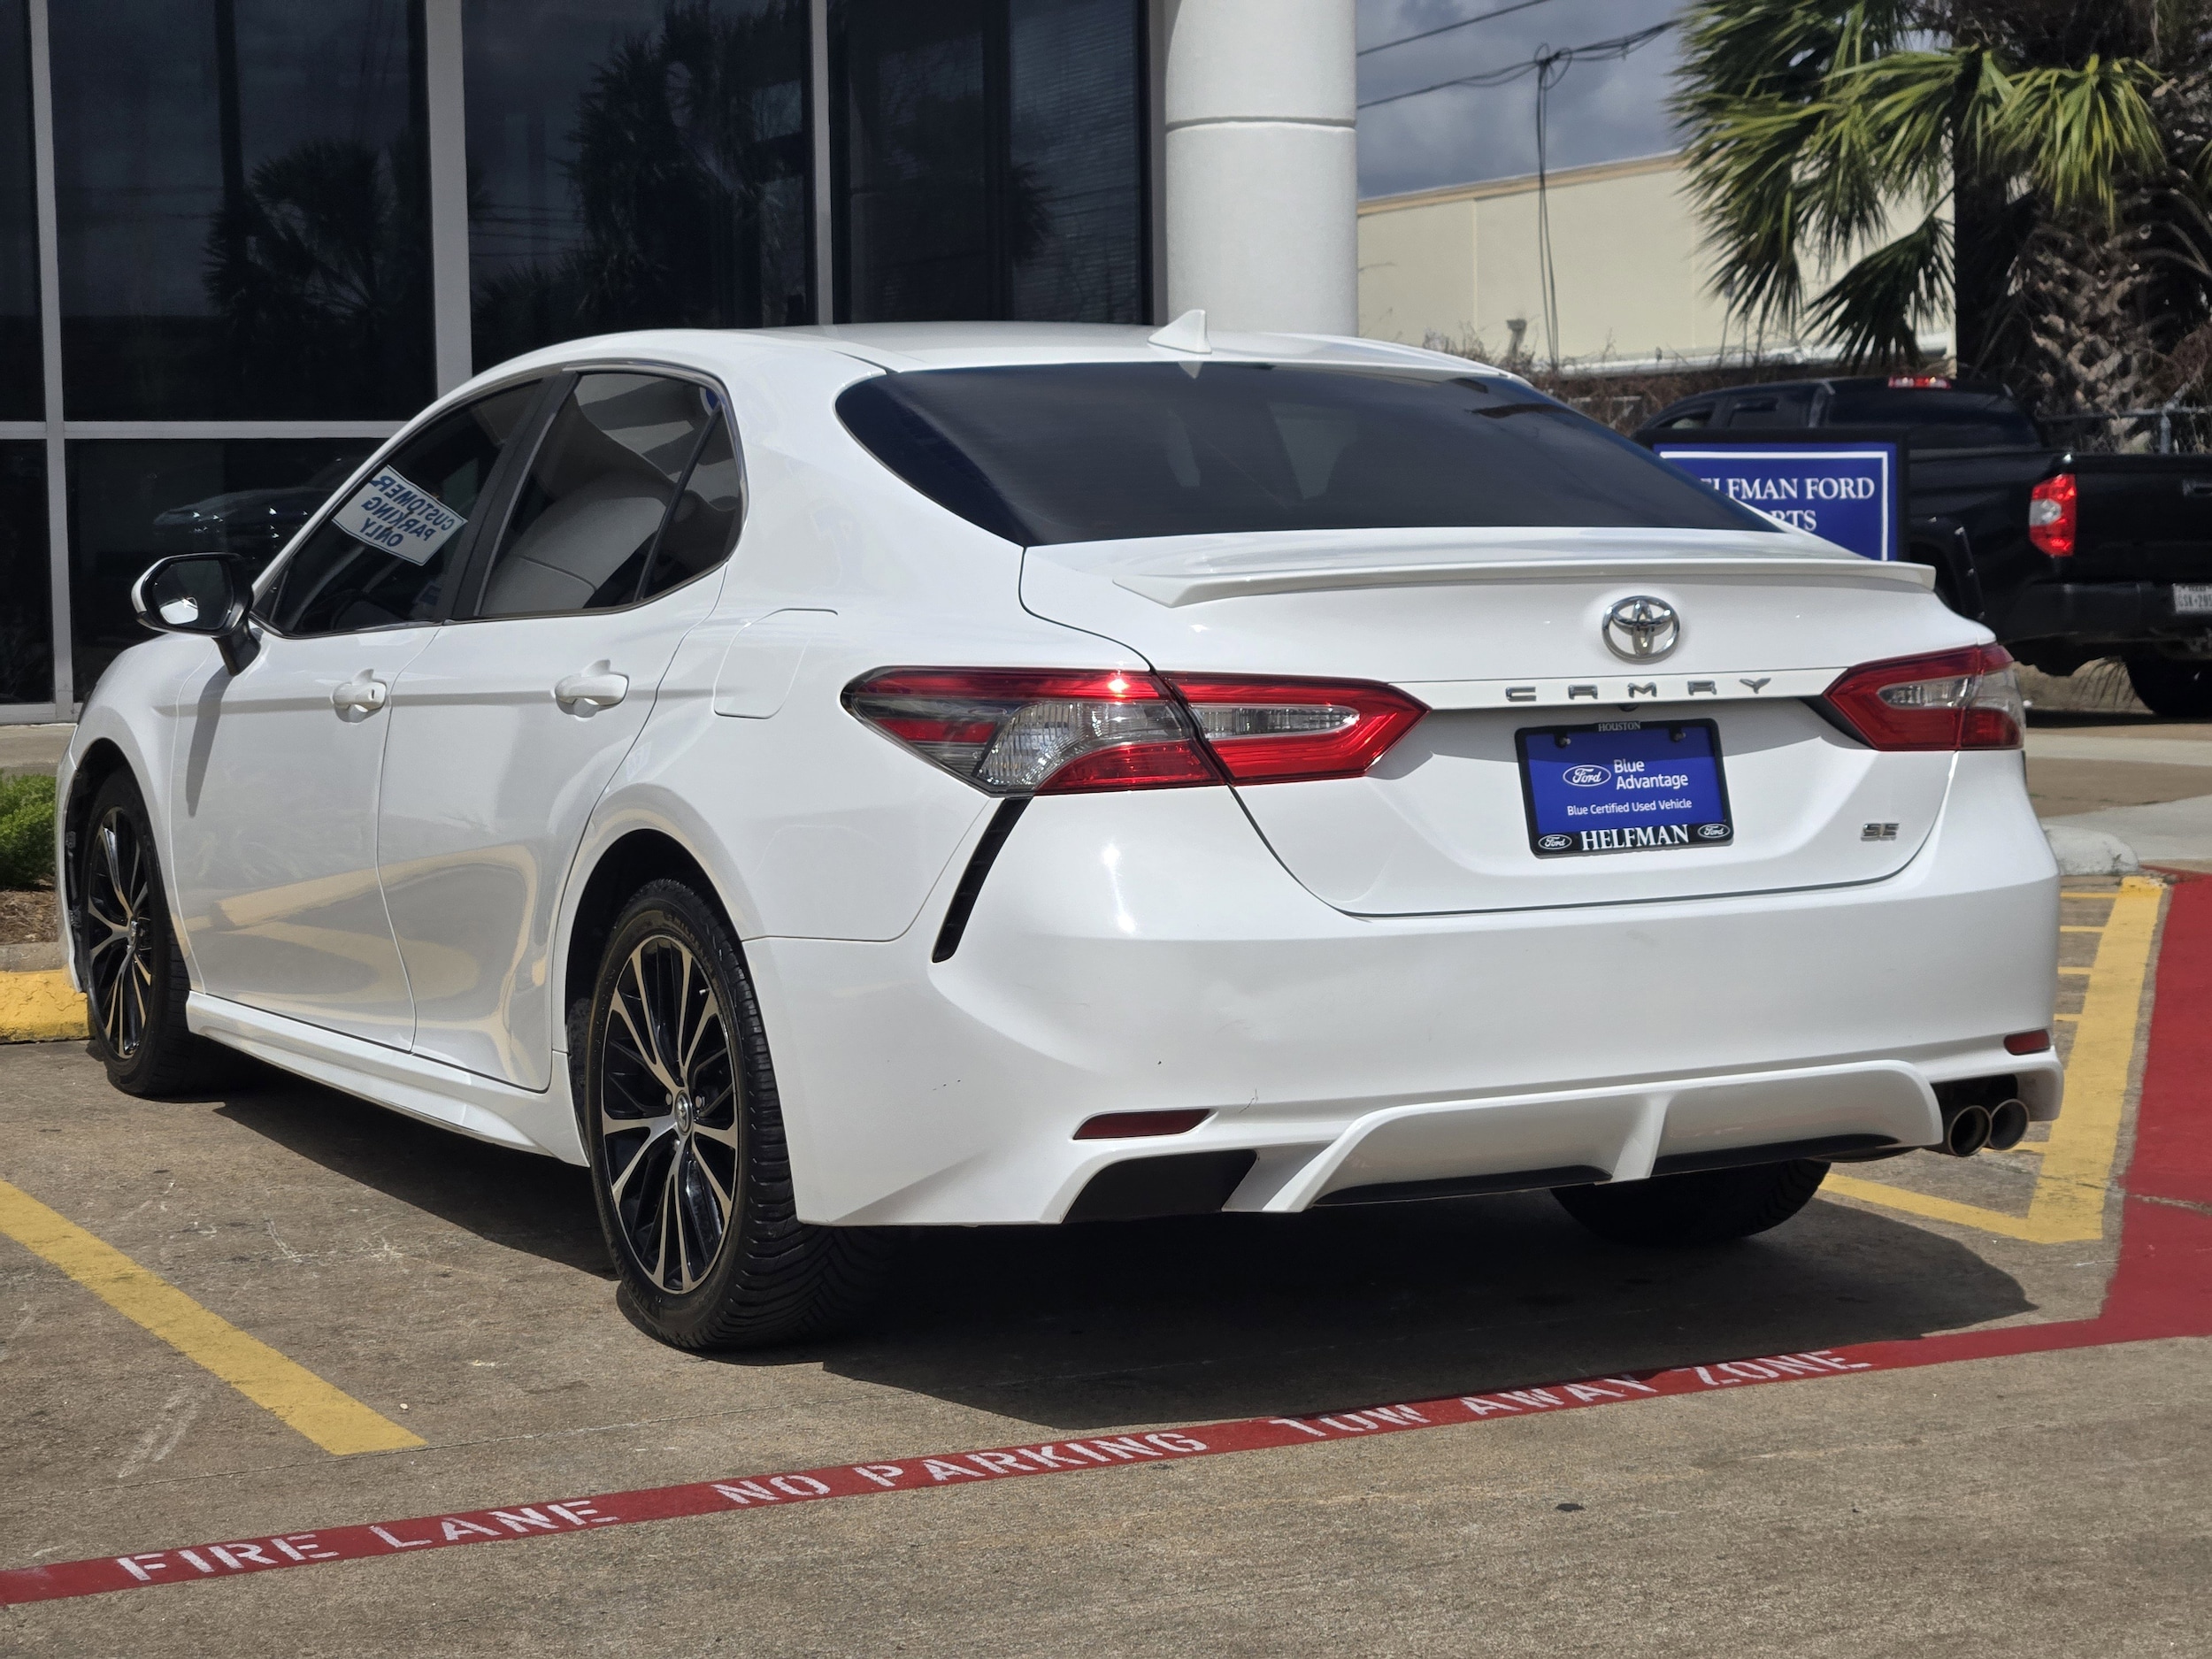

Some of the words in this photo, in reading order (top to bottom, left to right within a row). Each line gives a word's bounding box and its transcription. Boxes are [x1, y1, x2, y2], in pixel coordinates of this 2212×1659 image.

[1701, 478, 1798, 500] FMAN
[1805, 477, 1875, 500] FORD
[1505, 677, 1771, 702] CAMRY
[1598, 721, 1641, 733] HOUSTON
[1613, 758, 1645, 774] Blue
[1616, 772, 1689, 790] Advantage
[1567, 803, 1589, 816] Blue
[1590, 801, 1630, 815] Certified
[1632, 800, 1657, 812] Used
[1658, 798, 1693, 811] Vehicle
[1580, 824, 1690, 851] HELFMAN
[1861, 822, 1901, 841] SE
[116, 1532, 339, 1582] FIRE
[369, 1500, 619, 1549] LANE
[710, 1473, 832, 1504] NO
[851, 1432, 1209, 1488] PARKING
[1270, 1404, 1432, 1438] TOW
[1460, 1374, 1658, 1417] AWAY
[1677, 1350, 1872, 1386] ZONE
